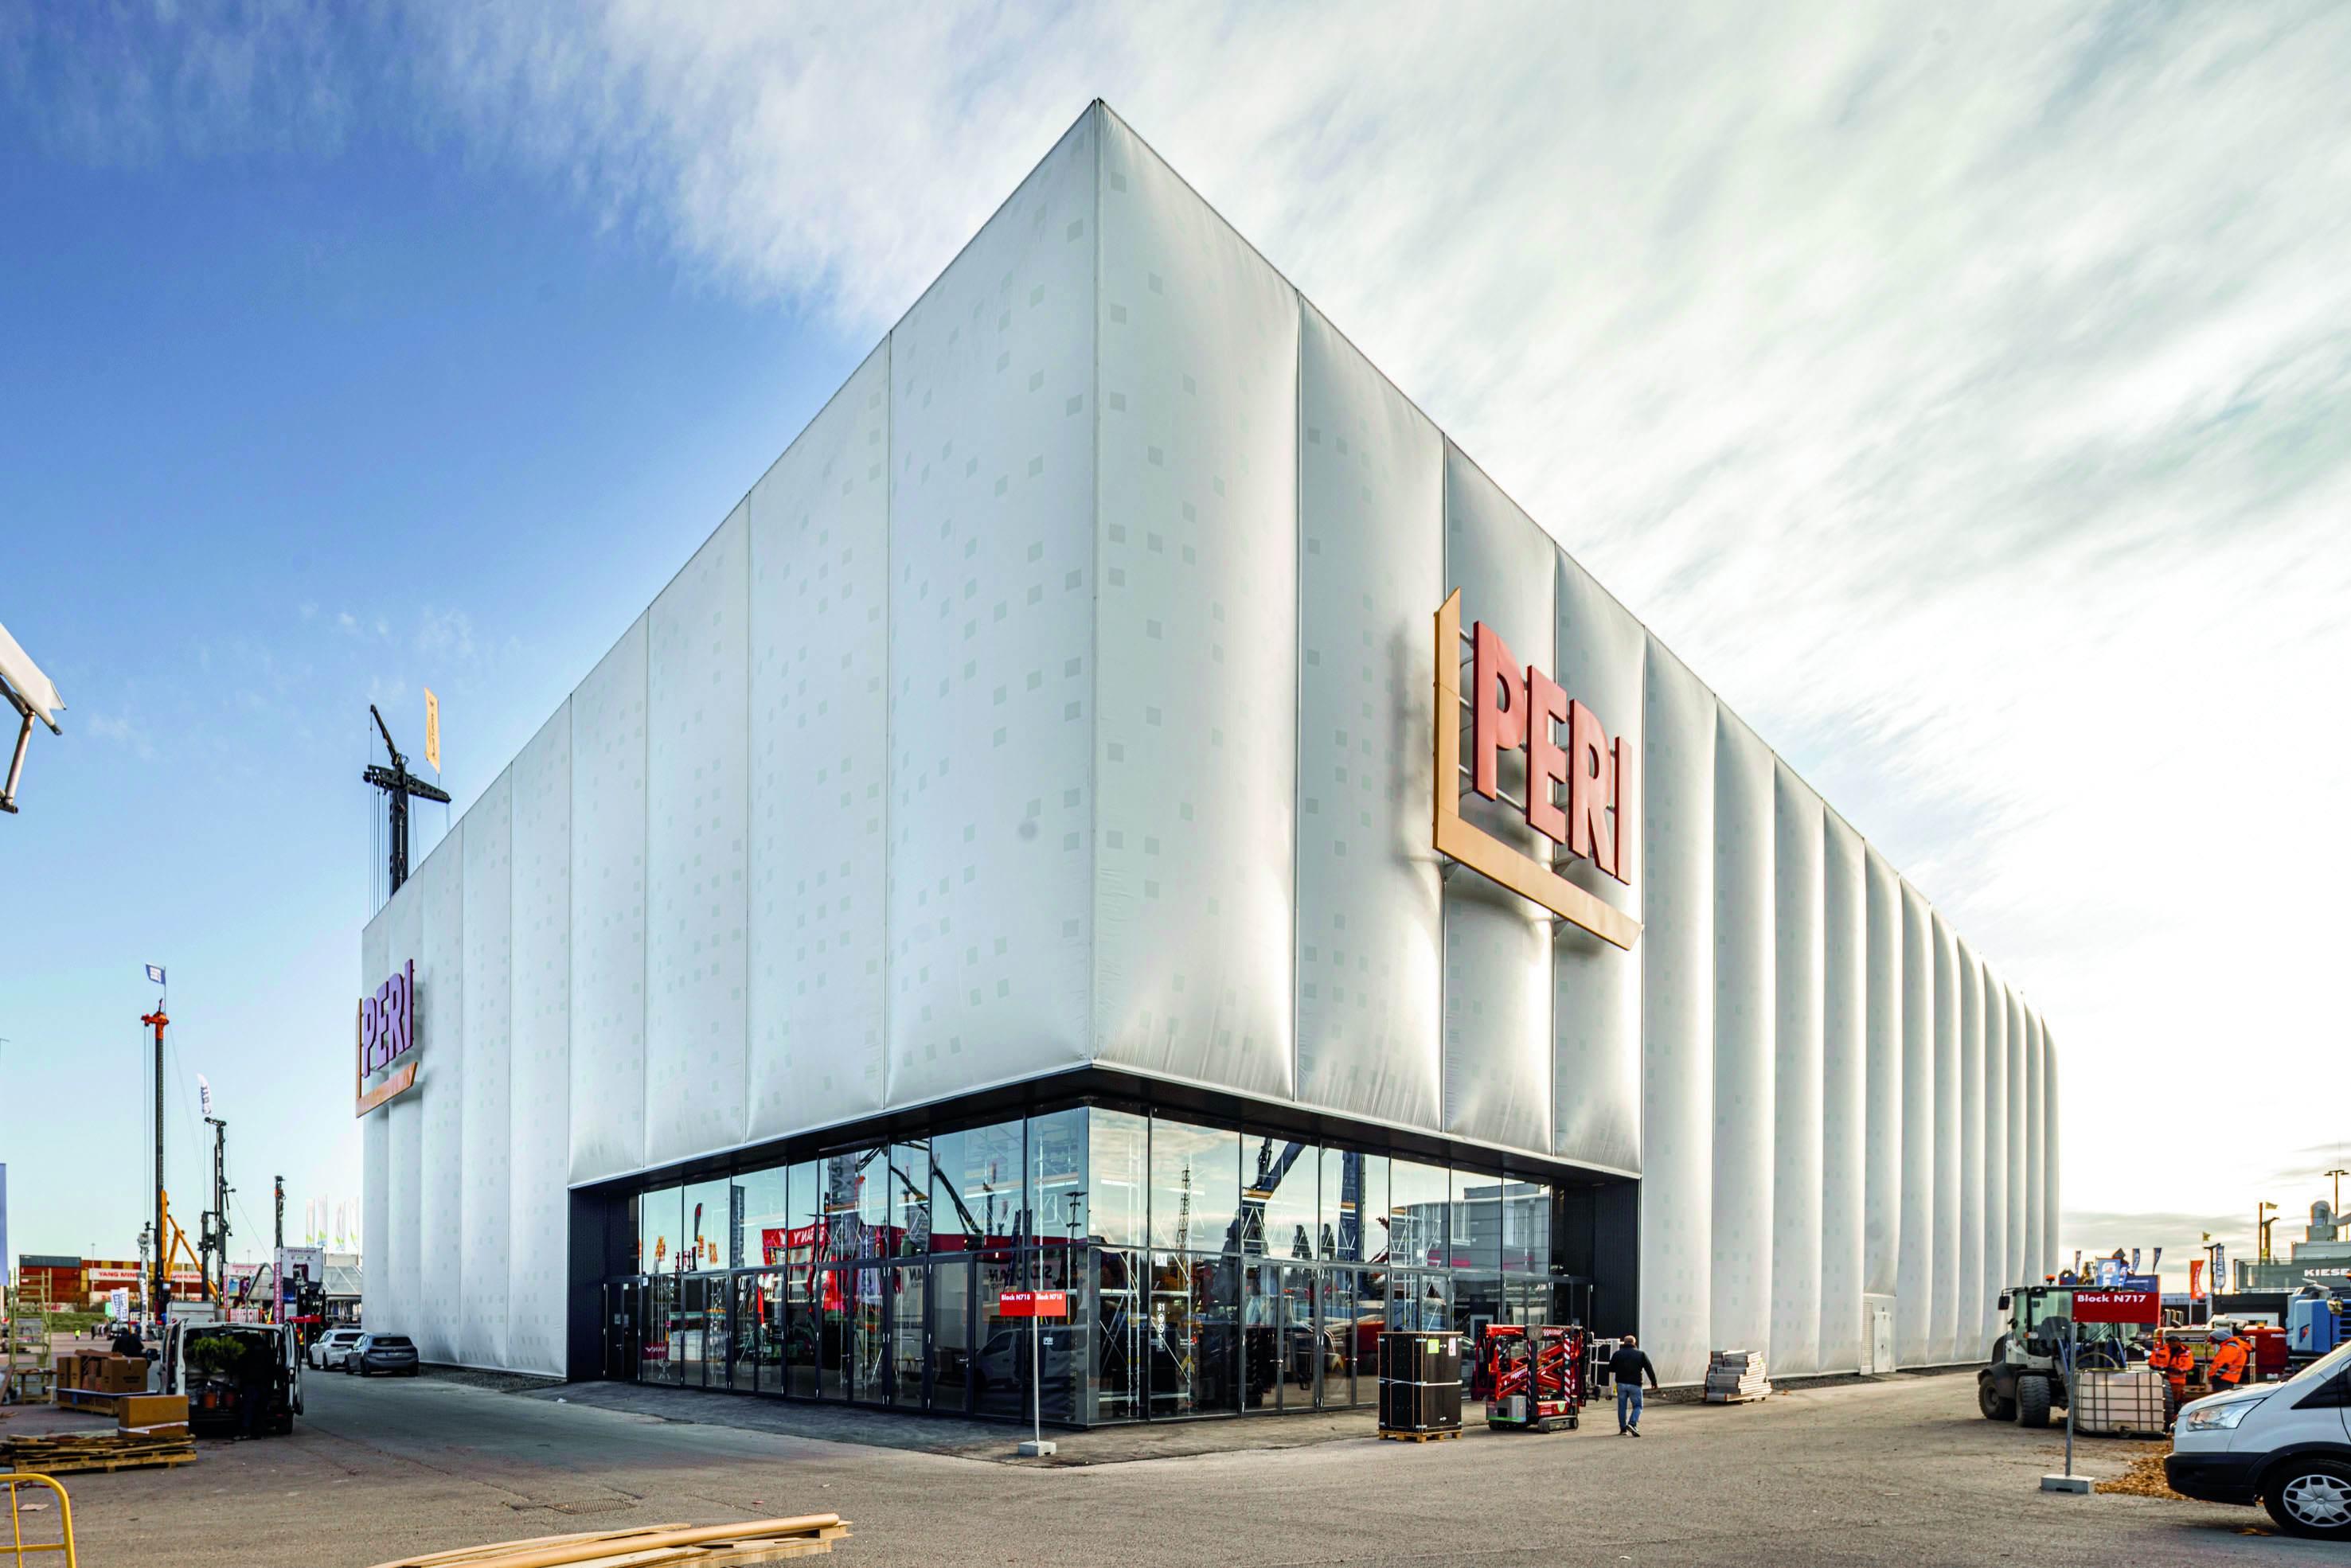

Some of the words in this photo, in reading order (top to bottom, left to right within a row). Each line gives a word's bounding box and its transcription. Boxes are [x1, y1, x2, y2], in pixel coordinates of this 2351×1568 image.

[1473, 620, 1632, 885] PERI
[363, 958, 414, 1078] PERI
[2077, 1293, 2109, 1302] Block
[2304, 1268, 2350, 1277] KIESE
